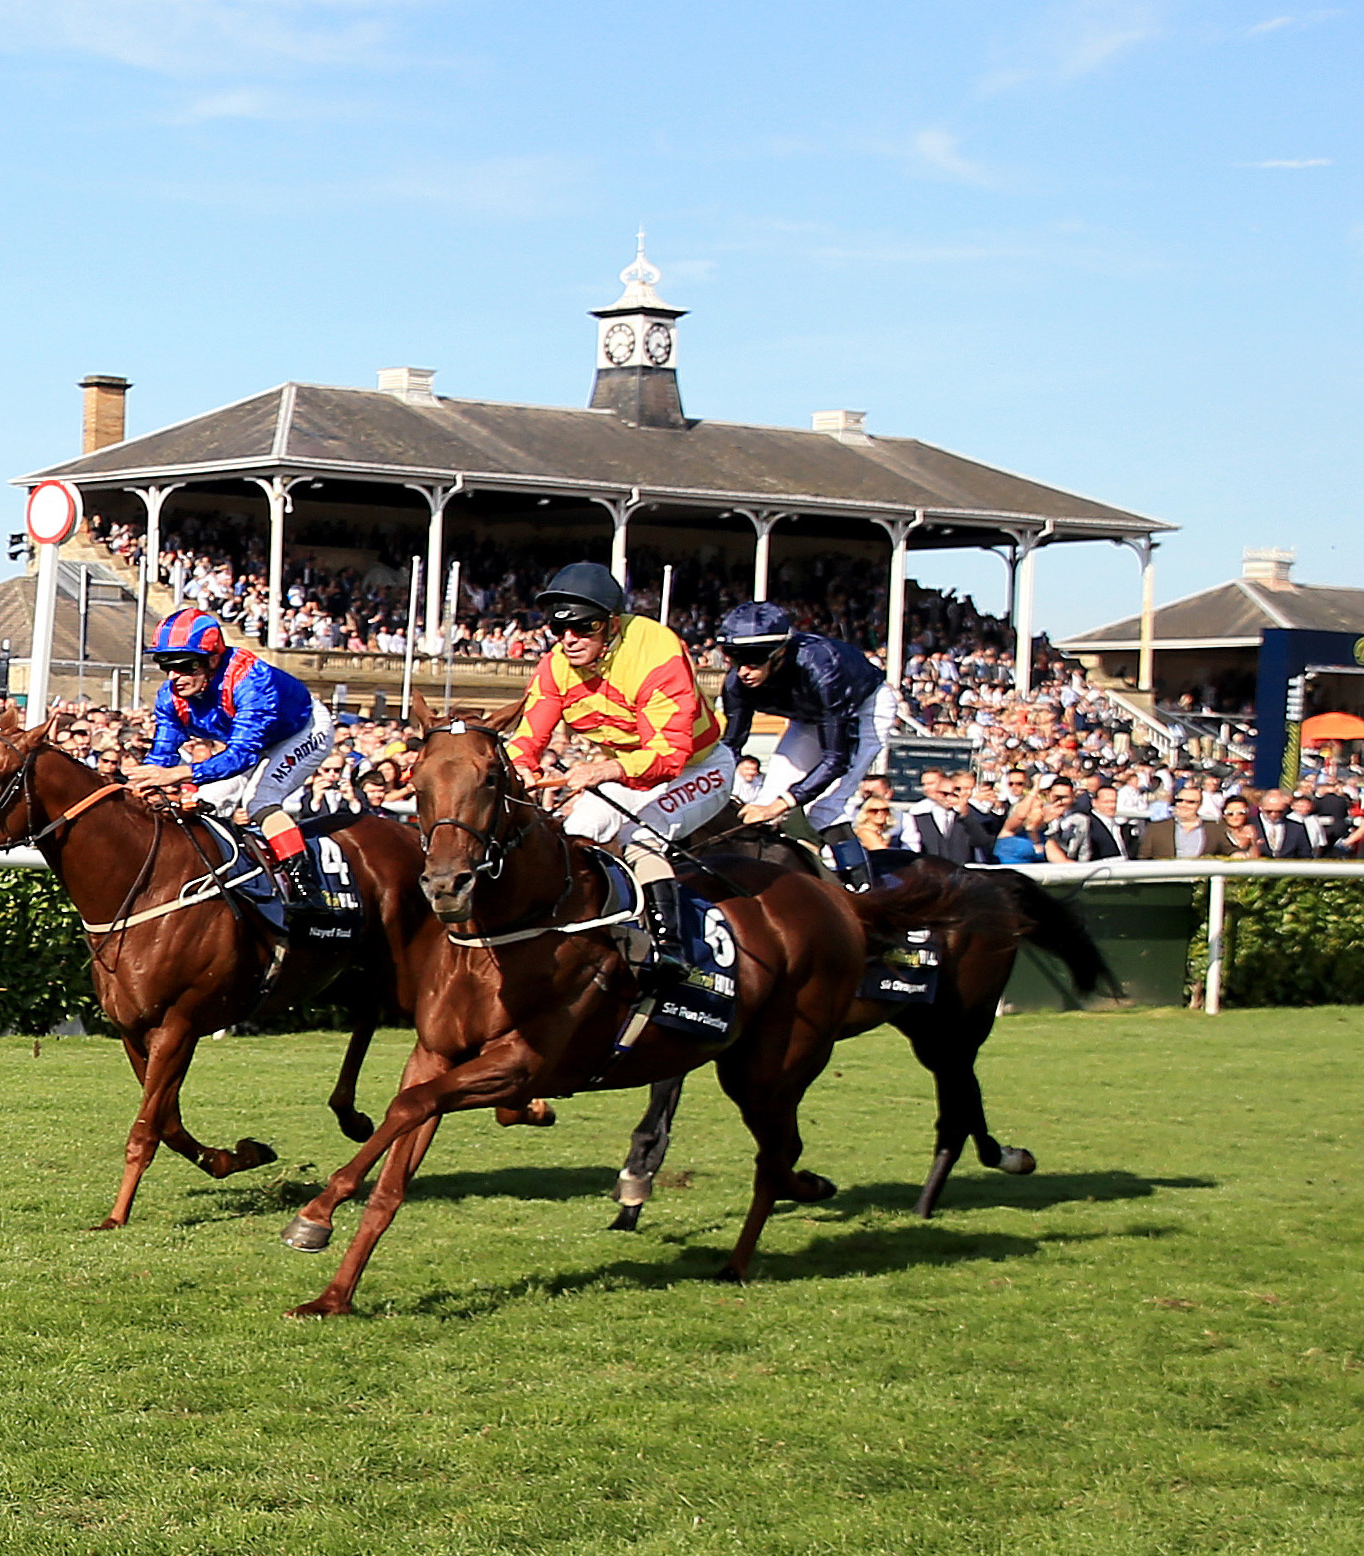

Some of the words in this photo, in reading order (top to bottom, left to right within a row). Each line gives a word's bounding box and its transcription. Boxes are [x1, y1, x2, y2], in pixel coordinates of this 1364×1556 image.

[271, 762, 292, 783] MS
[318, 836, 350, 885] 4
[309, 926, 336, 939] Nayef
[662, 1002, 678, 1015] Sir
